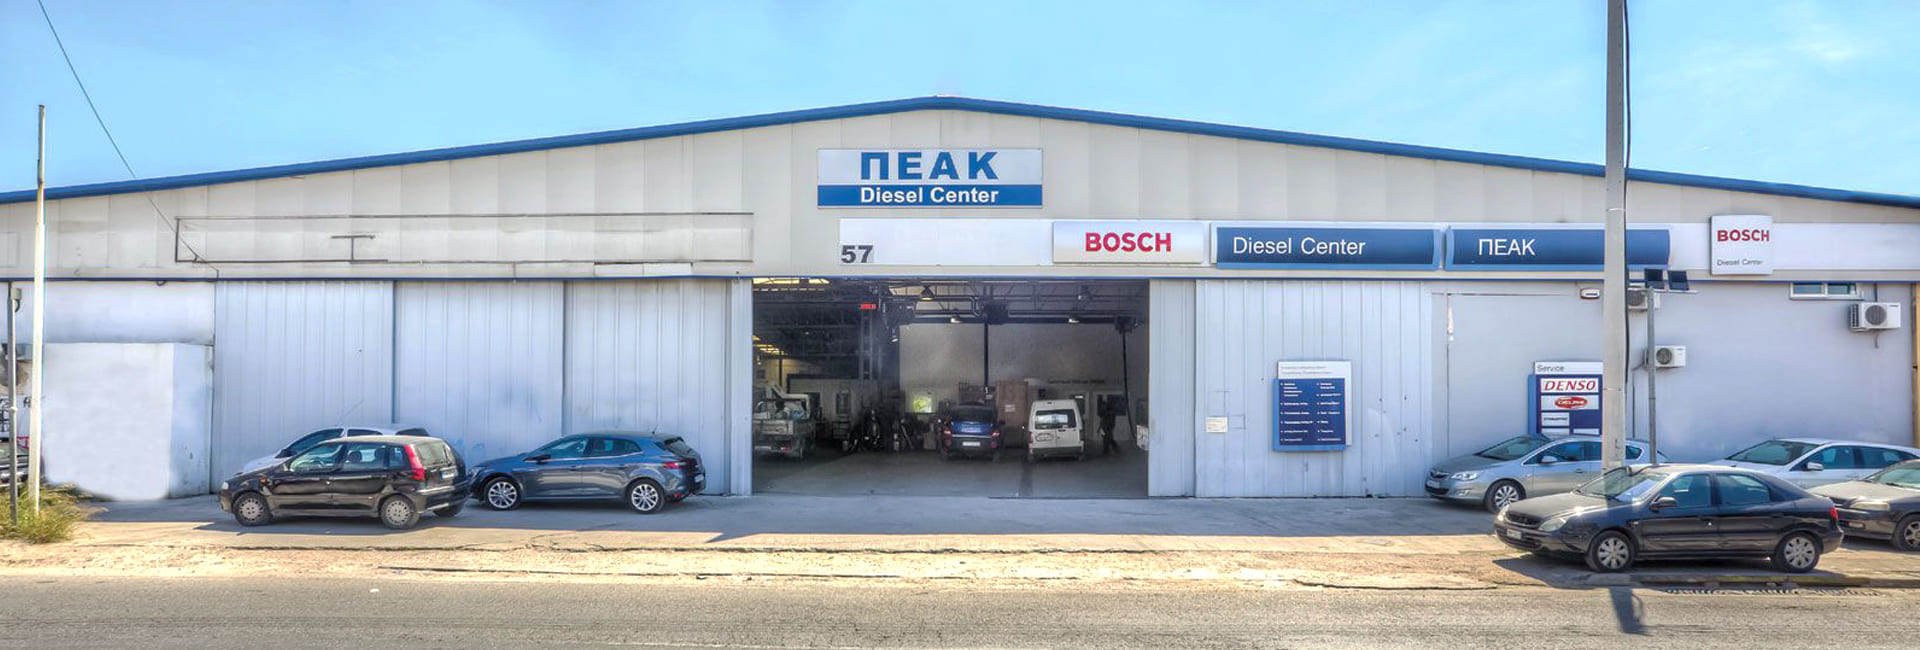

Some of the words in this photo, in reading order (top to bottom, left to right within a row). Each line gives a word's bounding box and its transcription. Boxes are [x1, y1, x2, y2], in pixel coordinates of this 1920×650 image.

[861, 152, 999, 180] ΠΕΑΚ
[861, 187, 923, 203] Diesel
[930, 187, 999, 203] Center
[1085, 232, 1171, 252] BOSCH
[1717, 229, 1770, 242] BOSCH
[841, 245, 873, 263] 57
[1233, 237, 1292, 254] Diesel
[1301, 237, 1366, 255] Center
[1479, 239, 1536, 256] ΠΕΑΚ
[1537, 364, 1565, 373] Service
[1544, 380, 1596, 391] DENSO
